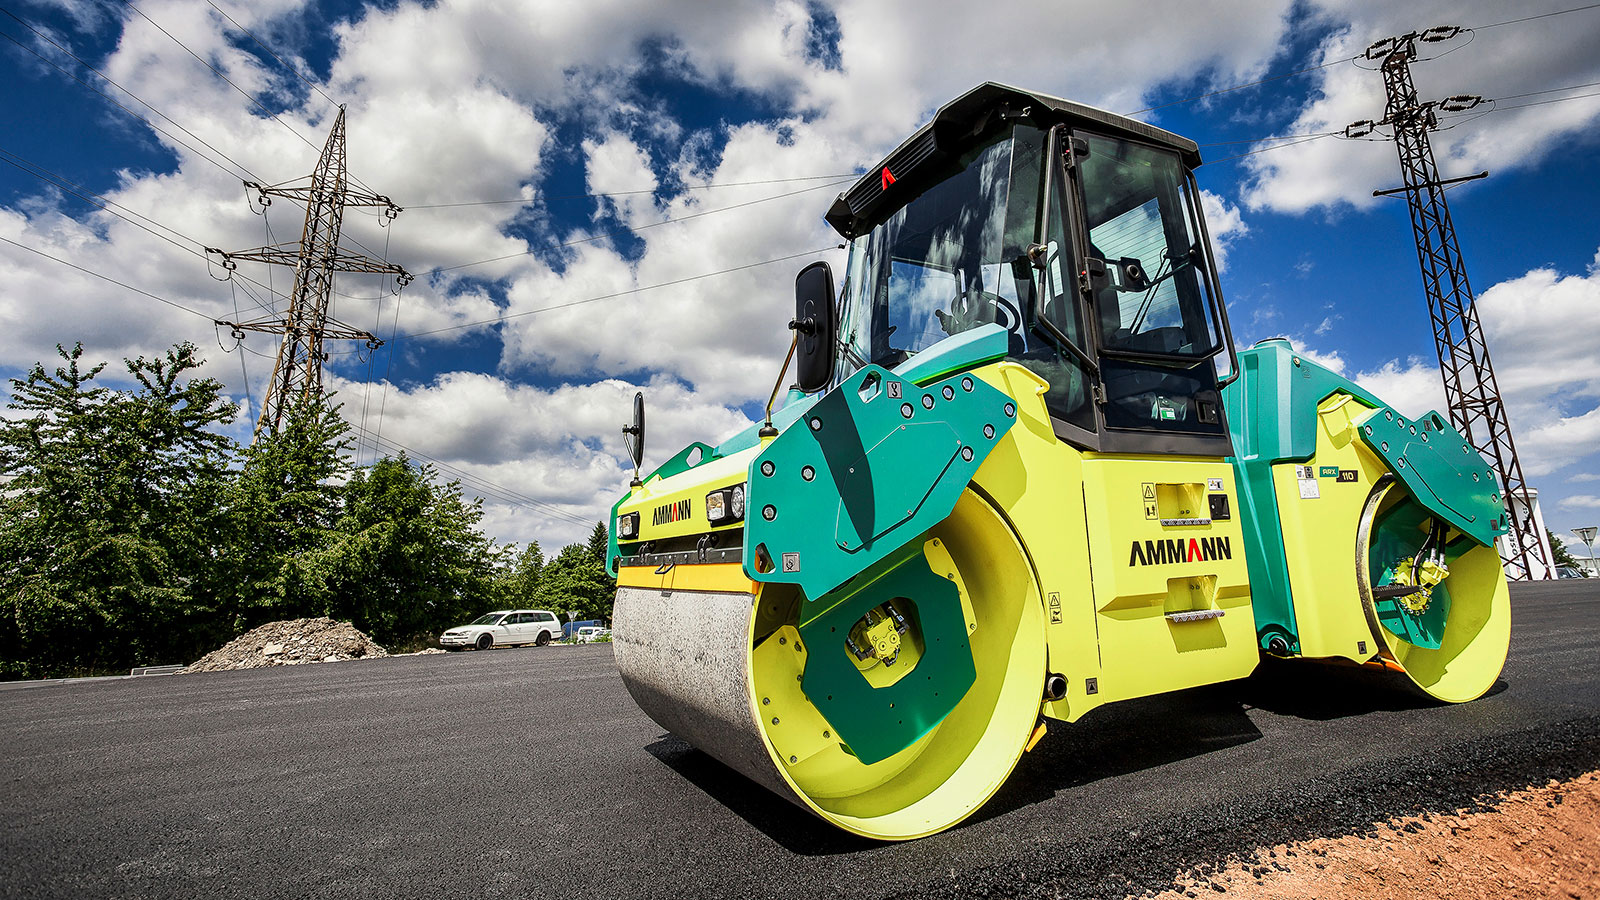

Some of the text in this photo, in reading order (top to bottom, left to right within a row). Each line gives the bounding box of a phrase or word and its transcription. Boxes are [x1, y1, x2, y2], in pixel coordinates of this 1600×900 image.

[1342, 472, 1354, 480] 110
[652, 498, 691, 526] AMMANN
[1129, 536, 1232, 567] AMMANN
